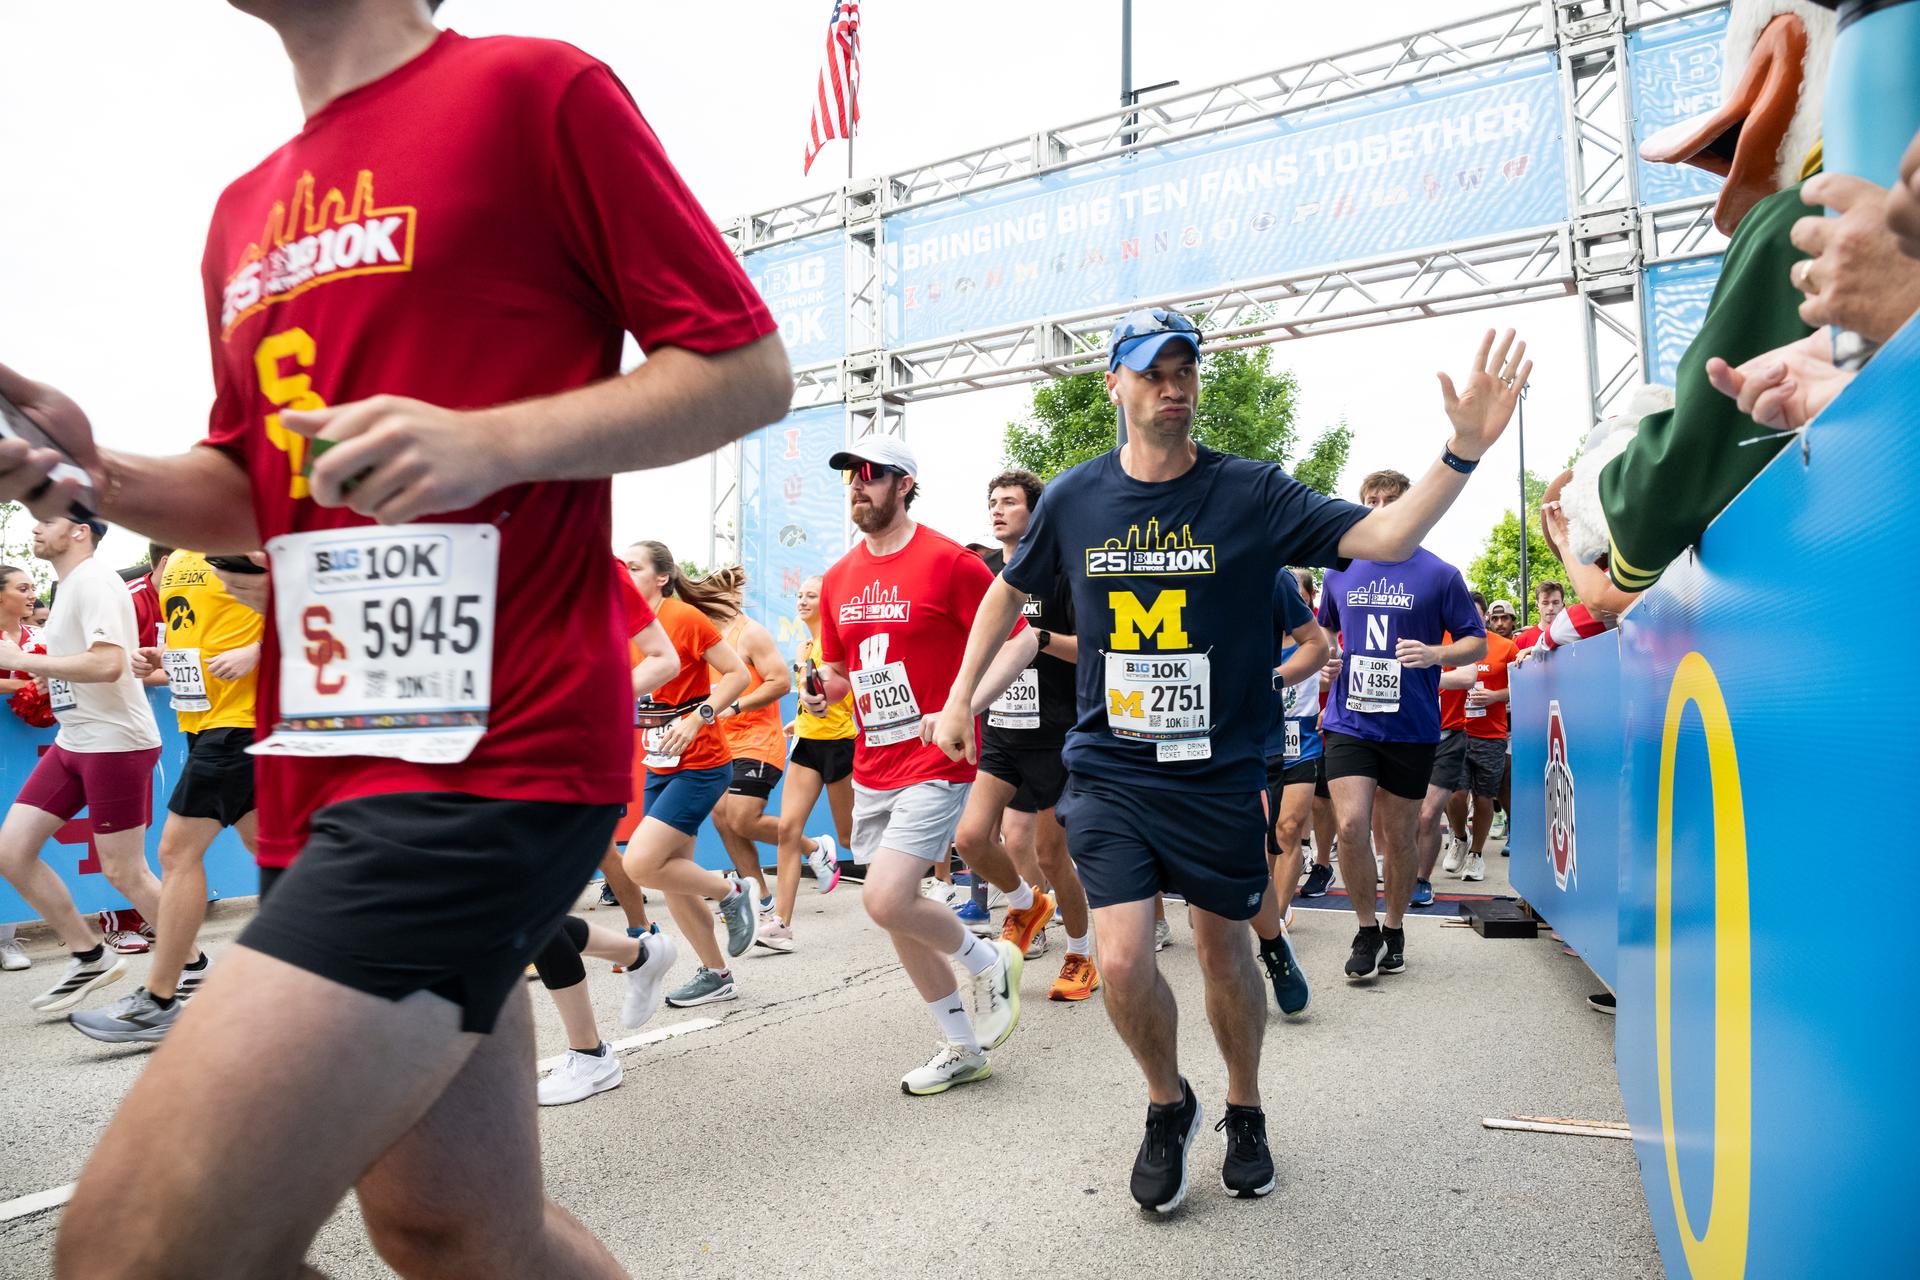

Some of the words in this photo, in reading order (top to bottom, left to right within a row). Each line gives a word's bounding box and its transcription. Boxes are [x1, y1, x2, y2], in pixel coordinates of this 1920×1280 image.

[904, 211, 1046, 272] BRINGING
[1057, 196, 1112, 235] BIG
[1119, 178, 1188, 220] TEN
[1200, 154, 1298, 203] FANS
[1309, 102, 1531, 177] TOGETHER
[314, 216, 404, 275] 10K
[780, 306, 827, 348] 0K
[365, 543, 440, 581] 10K
[1089, 552, 1128, 573] 25
[1166, 550, 1211, 572] 10K
[1349, 594, 1368, 605] 25
[1387, 594, 1411, 608] 10K
[841, 605, 863, 621] 25
[879, 603, 906, 620] 10K
[1108, 589, 1188, 651] M
[362, 594, 480, 660] 5945
[1365, 613, 1389, 651] N
[173, 666, 201, 683] 2173
[1152, 662, 1187, 679] 10K
[1370, 661, 1389, 671] 10K
[870, 670, 892, 686] 10K
[1352, 670, 1364, 693] N
[1367, 673, 1399, 689] 4352
[873, 683, 911, 710] 6120
[1005, 685, 1036, 701] 5320
[1151, 683, 1205, 713] 2751
[909, 705, 917, 715] A
[1108, 688, 1145, 719] M
[1165, 717, 1182, 729] 10K
[1198, 714, 1205, 728] A
[1160, 751, 1181, 759] TICKET
[1161, 744, 1179, 752] FOOD
[1187, 749, 1208, 757] TICKET
